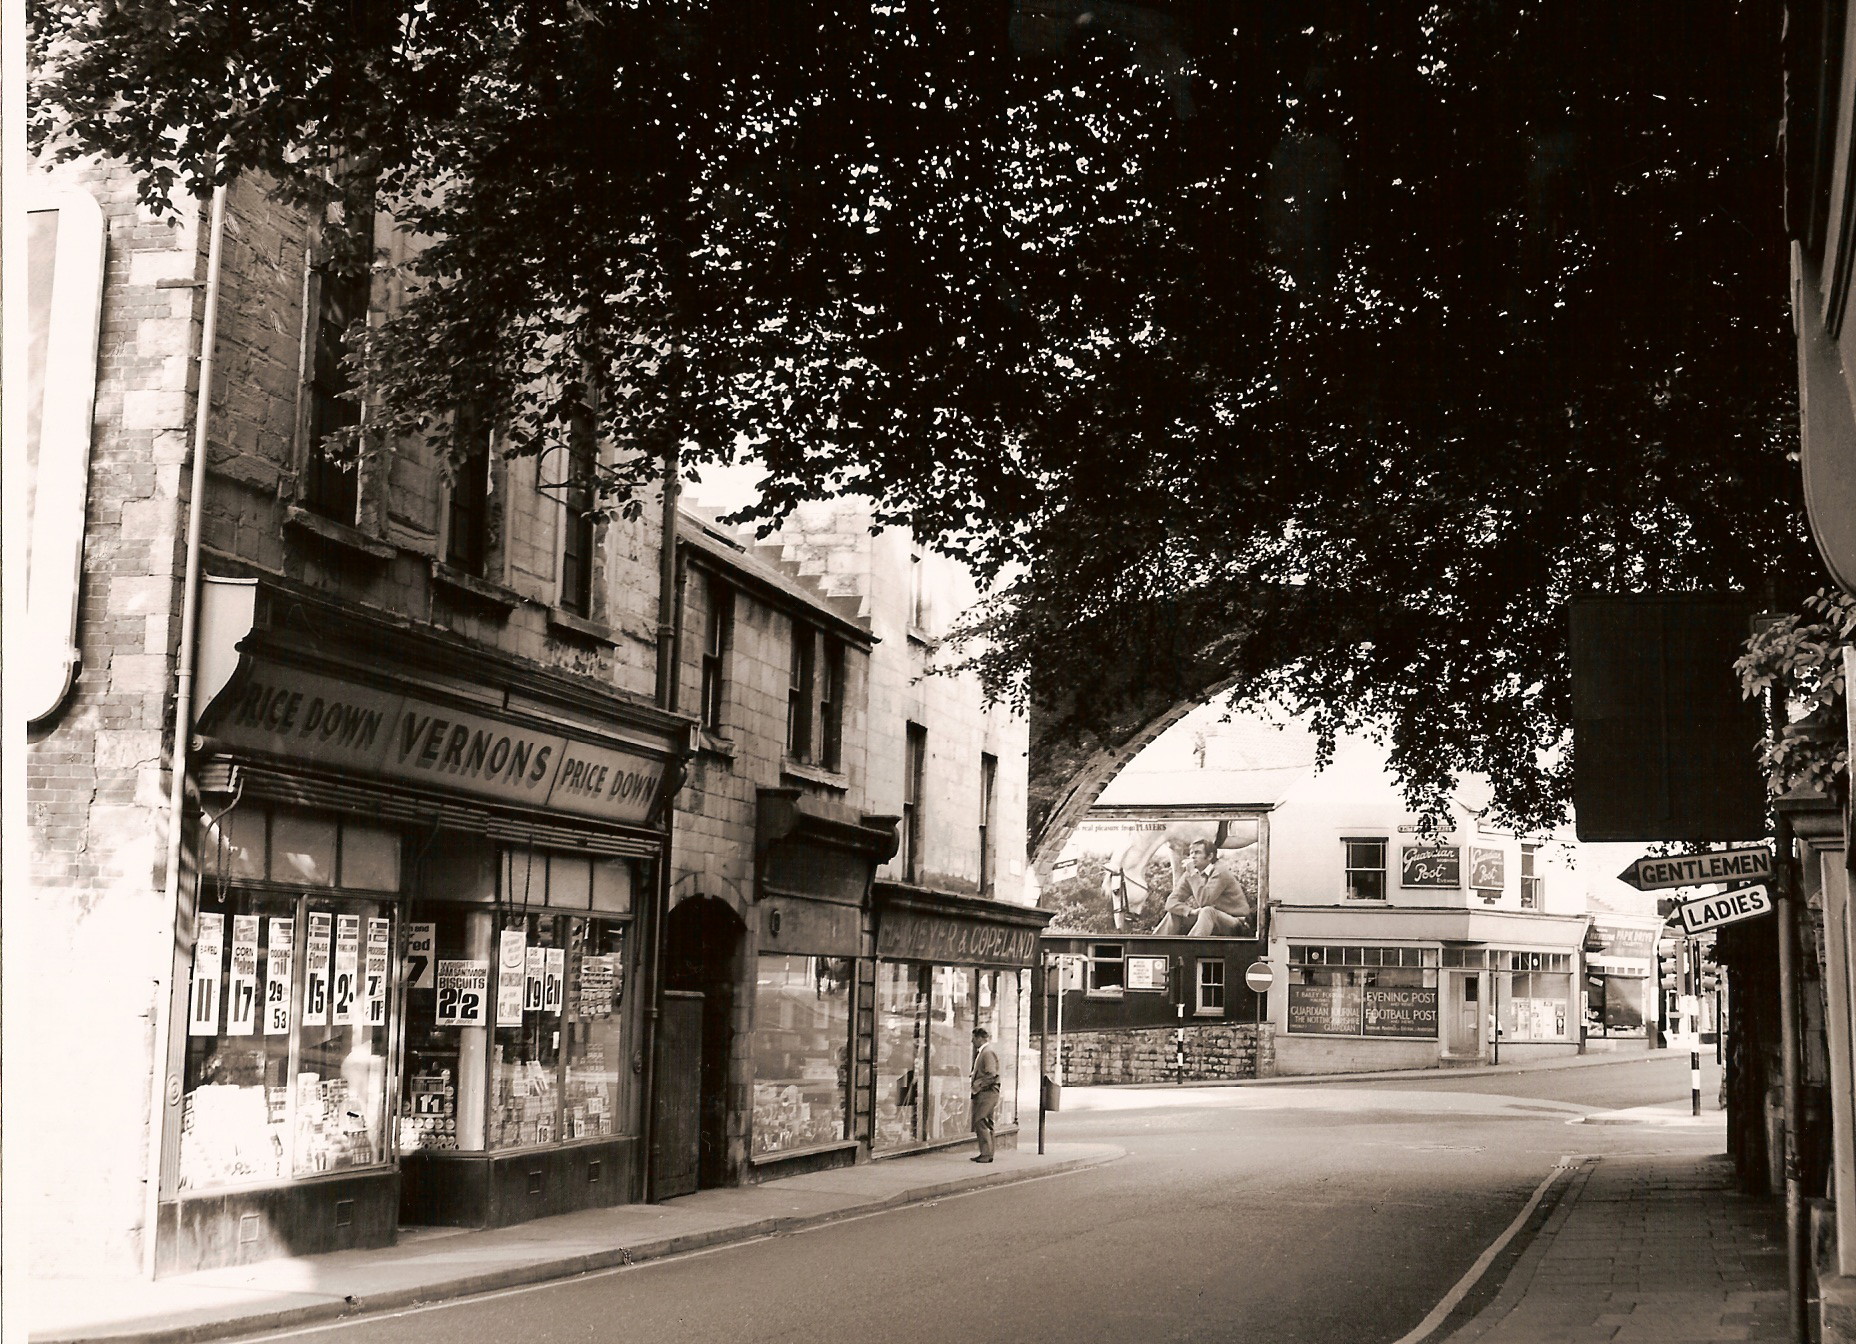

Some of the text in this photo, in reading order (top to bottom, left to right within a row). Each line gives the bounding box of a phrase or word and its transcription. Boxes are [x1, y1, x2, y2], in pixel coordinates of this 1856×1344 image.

[303, 697, 383, 748] DOWN
[401, 712, 553, 783] VERNONS
[561, 757, 657, 804] PRICE DOWN
[1414, 863, 1447, 882] Post
[1479, 865, 1498, 884] Post
[1642, 853, 1768, 884] GENTLEMEN
[1687, 891, 1764, 927] LADIES
[958, 929, 968, 954] &
[235, 947, 254, 957] CORN
[270, 949, 291, 958] COOKING
[273, 957, 288, 976] oil
[439, 977, 485, 989] BISCUITS
[438, 988, 480, 1020] 2'2
[1366, 991, 1409, 1003] EVENING
[1411, 992, 1436, 1004] POST
[1290, 1006, 1329, 1016] GUARDIAN
[1365, 1008, 1437, 1021] FOOTBALL POST
[1323, 1024, 1356, 1032] GUARDIAN
